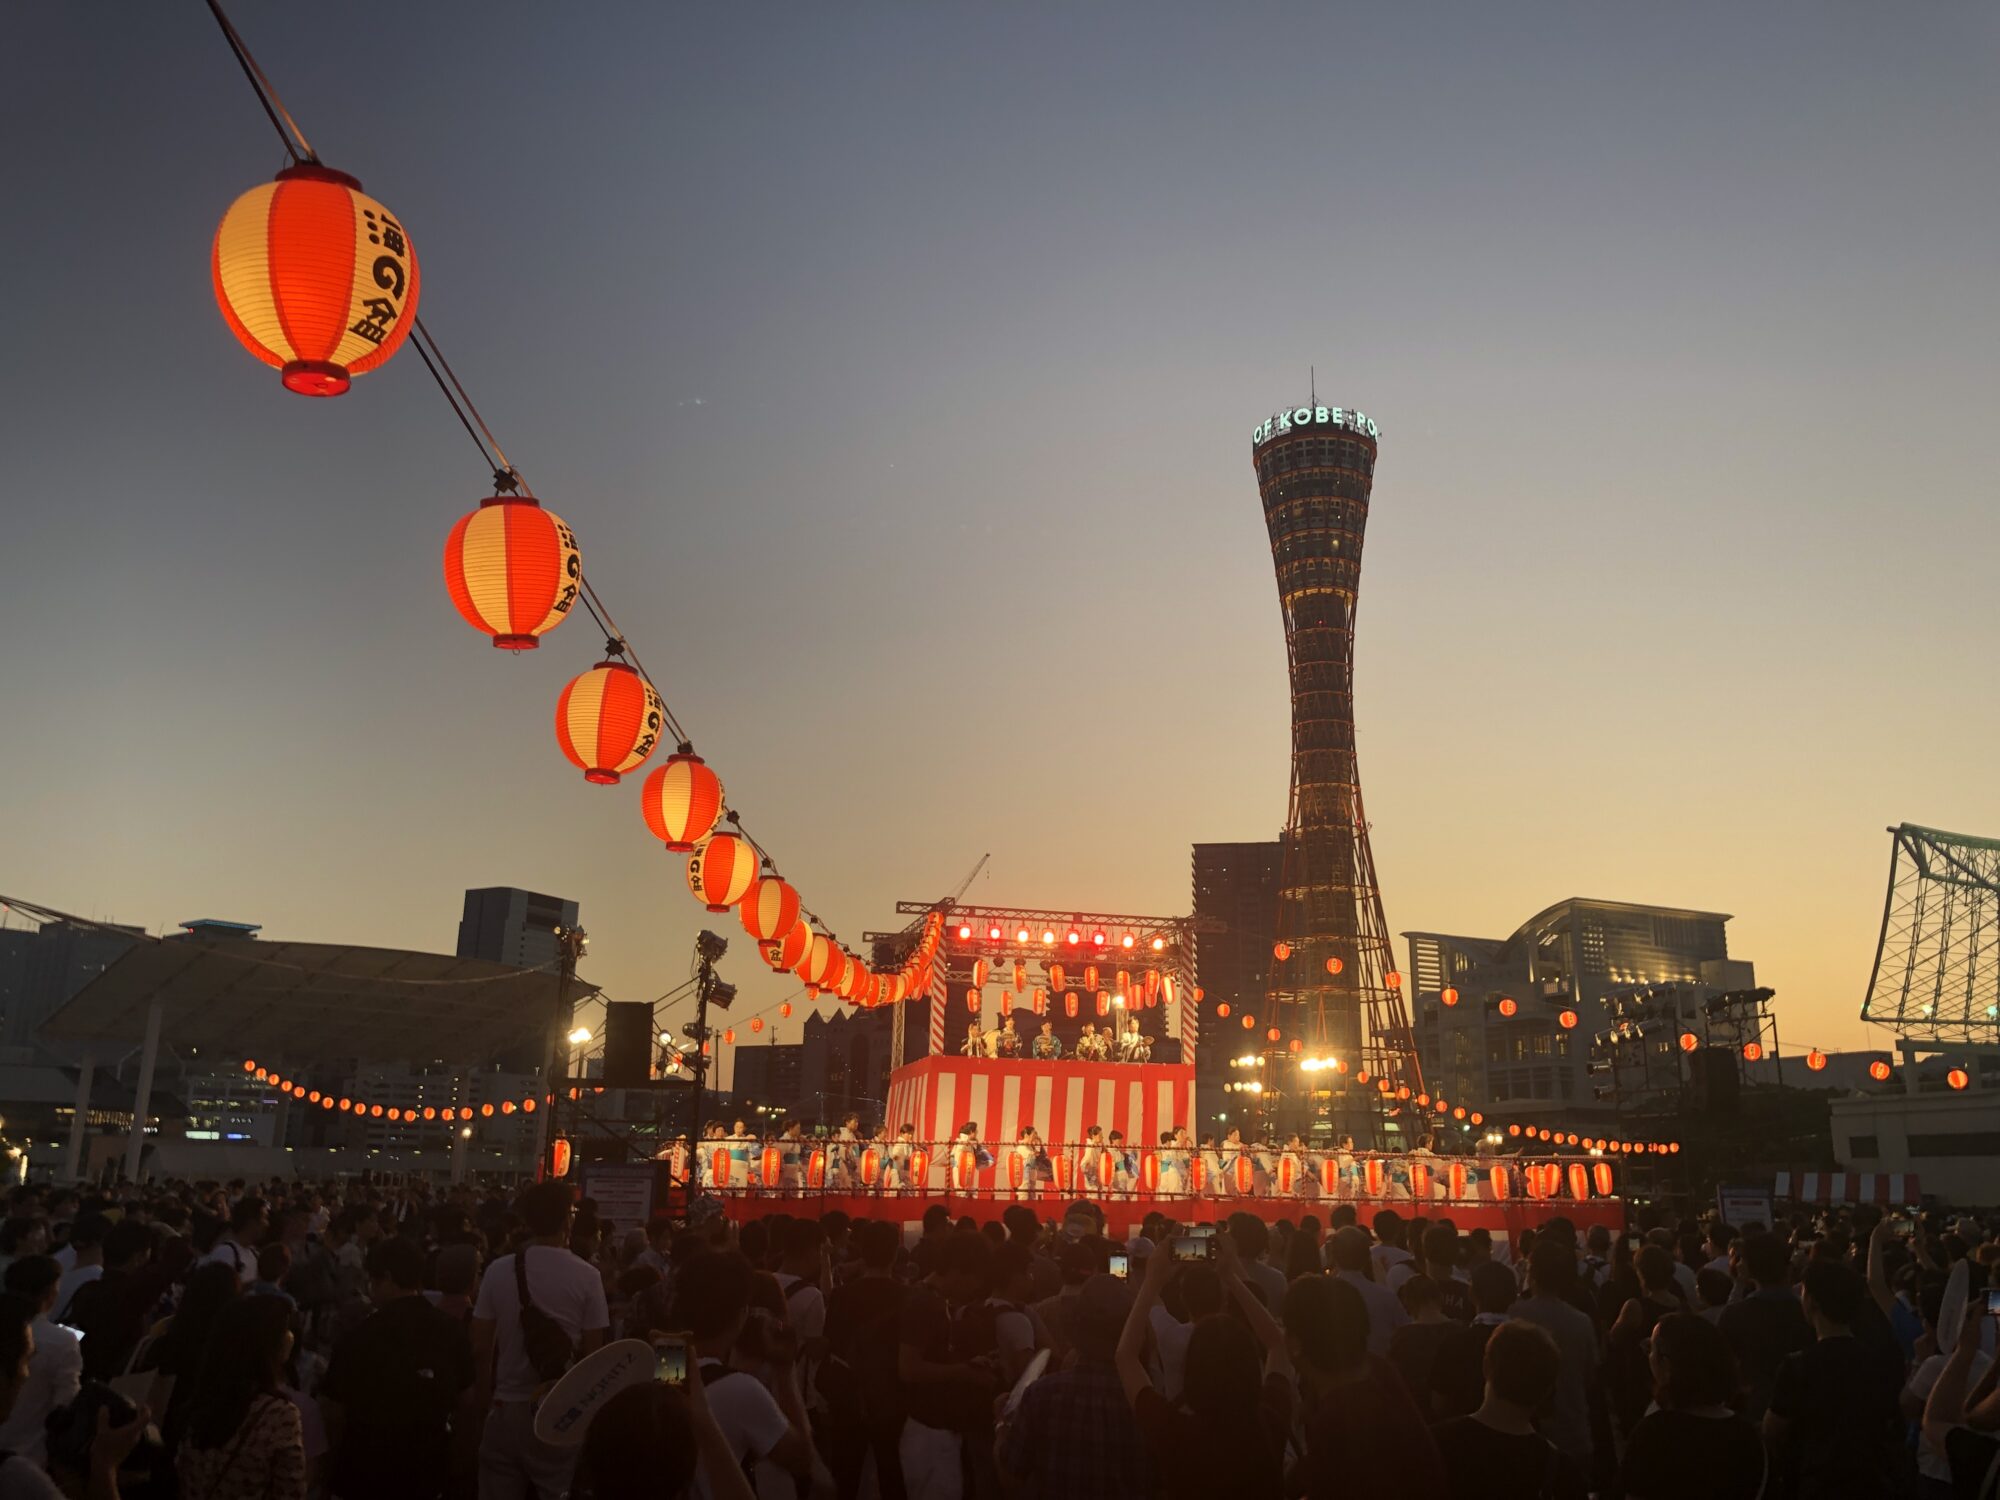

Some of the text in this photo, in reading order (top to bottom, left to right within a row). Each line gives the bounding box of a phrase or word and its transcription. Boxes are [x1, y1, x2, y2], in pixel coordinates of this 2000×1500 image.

[348, 209, 404, 345] 海の盆
[1253, 417, 1272, 444] OF
[1279, 406, 1343, 430] KOBE
